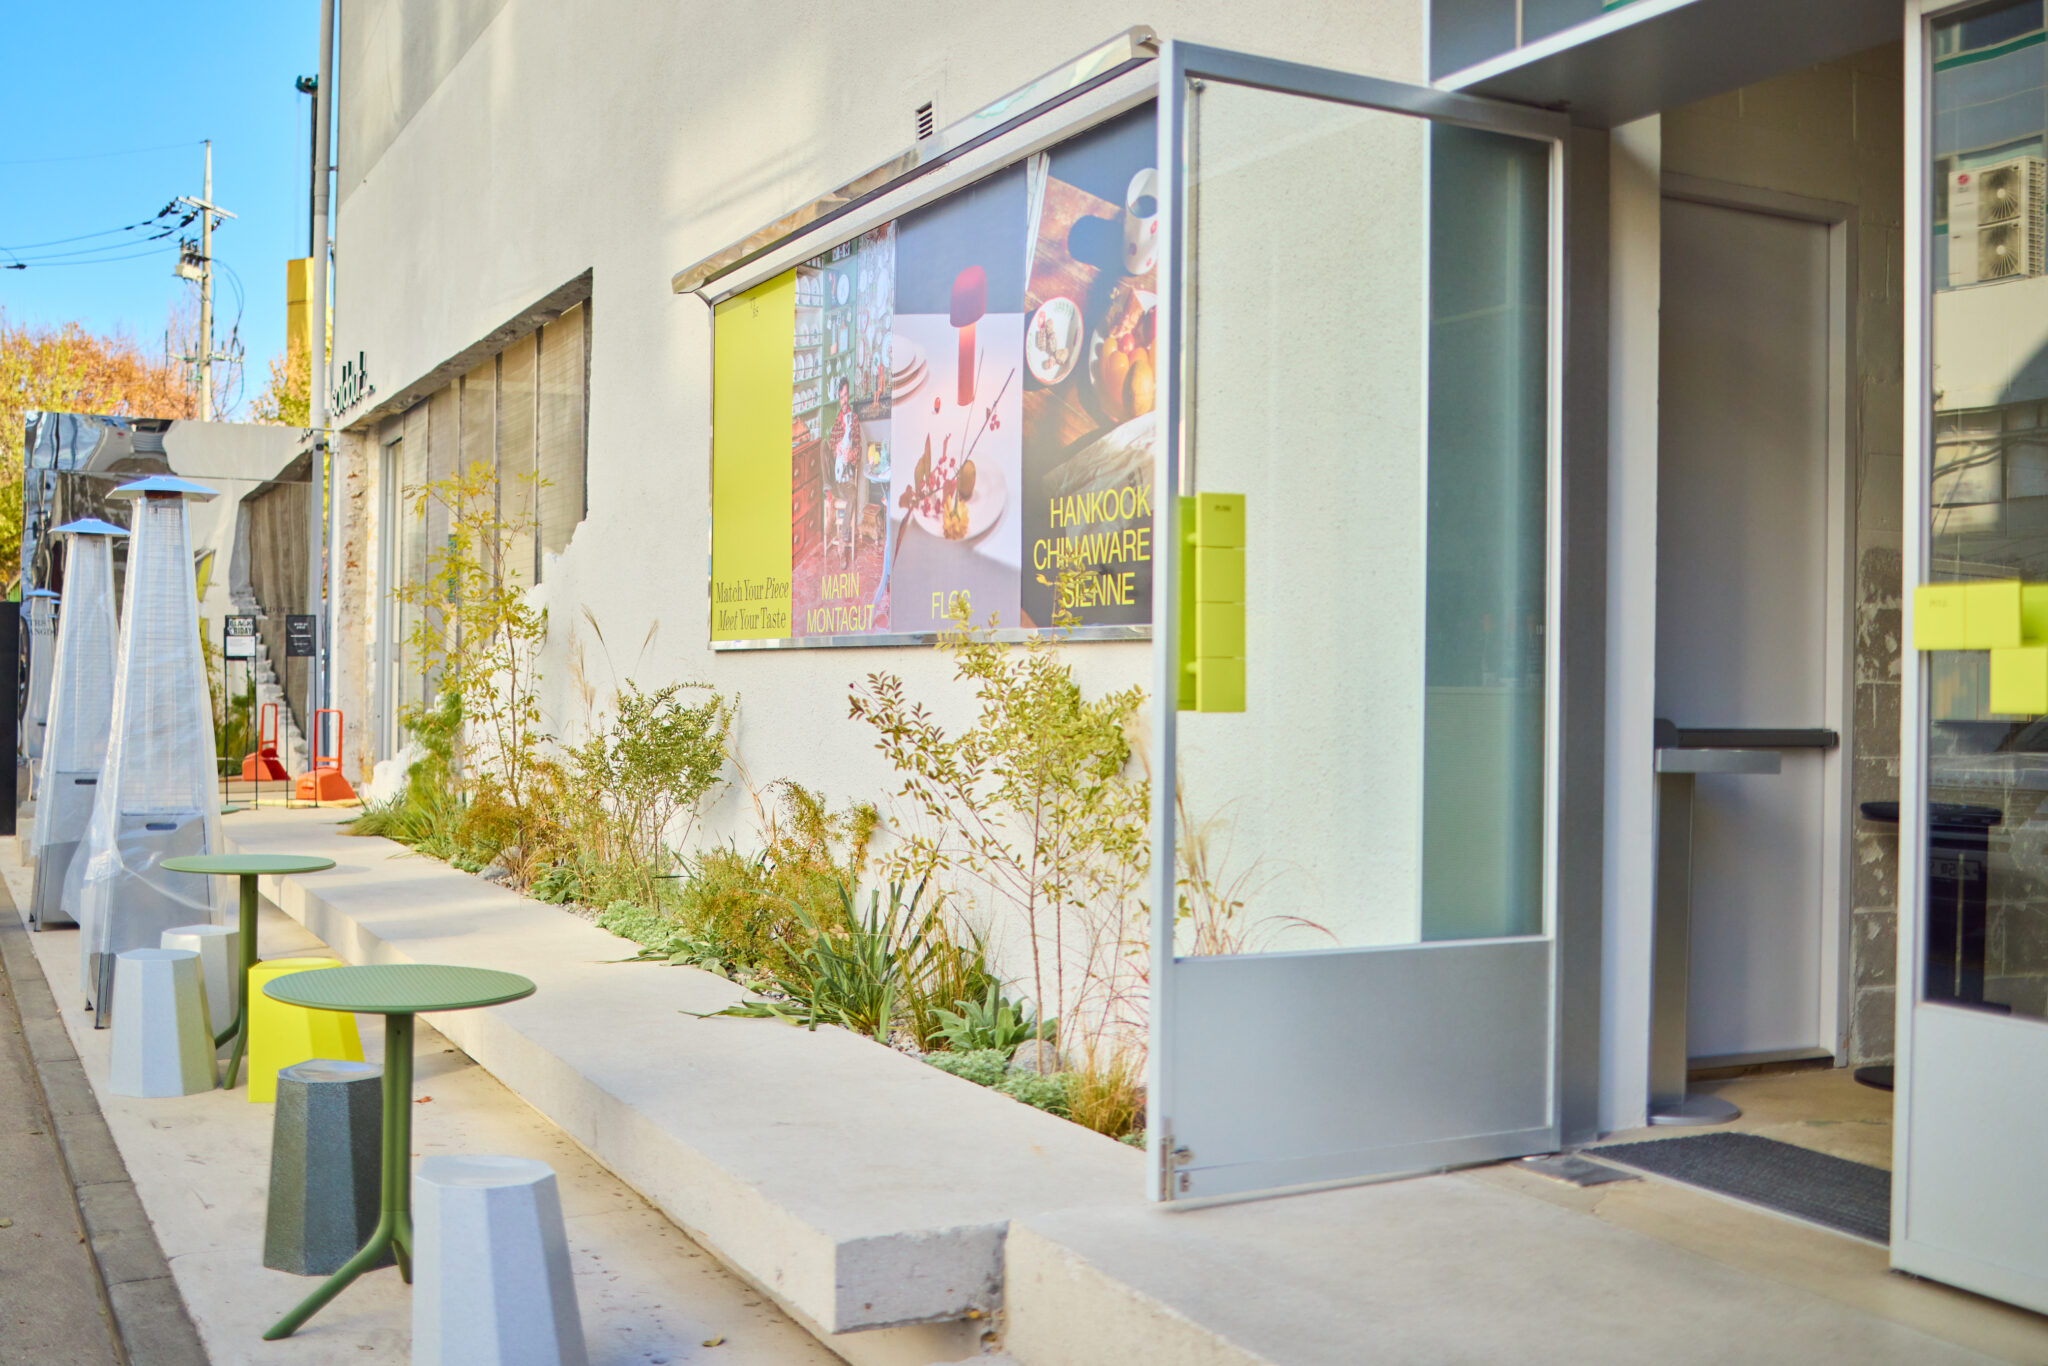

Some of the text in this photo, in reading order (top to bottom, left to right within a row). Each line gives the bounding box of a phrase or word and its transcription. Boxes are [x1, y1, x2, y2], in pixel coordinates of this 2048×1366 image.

[1050, 484, 1152, 528] HANKOOK
[1033, 527, 1151, 571] CHINAWARE
[716, 576, 790, 604] Match Your Piece
[821, 572, 860, 600] MARIN
[717, 606, 787, 632] Meet Your Taste
[806, 604, 875, 633] MONTAGUT
